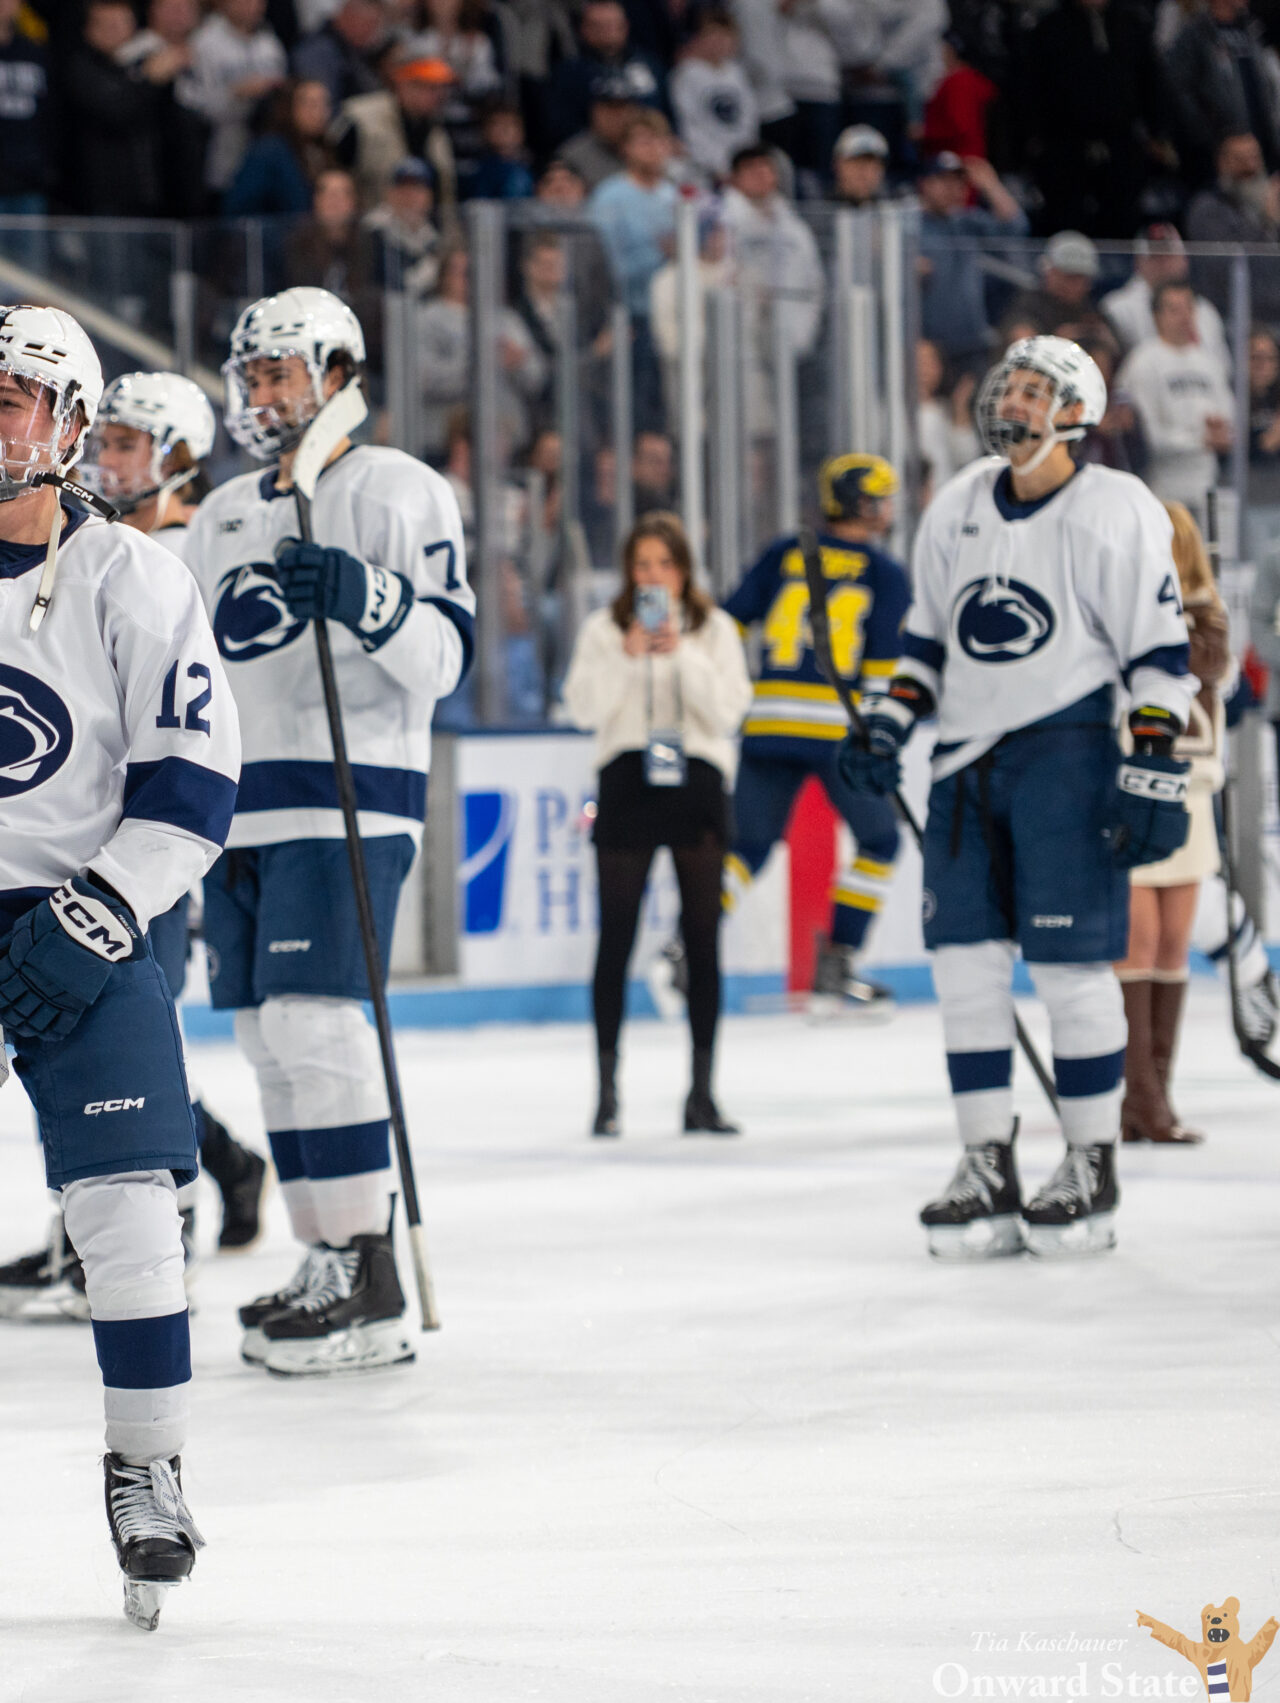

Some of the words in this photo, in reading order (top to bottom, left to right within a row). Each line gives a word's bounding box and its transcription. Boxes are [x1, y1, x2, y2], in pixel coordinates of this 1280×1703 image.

[61, 481, 95, 503] CCM
[423, 540, 462, 592] 7
[155, 659, 214, 739] 12
[51, 884, 126, 956] CCM
[83, 1096, 146, 1116] CCM
